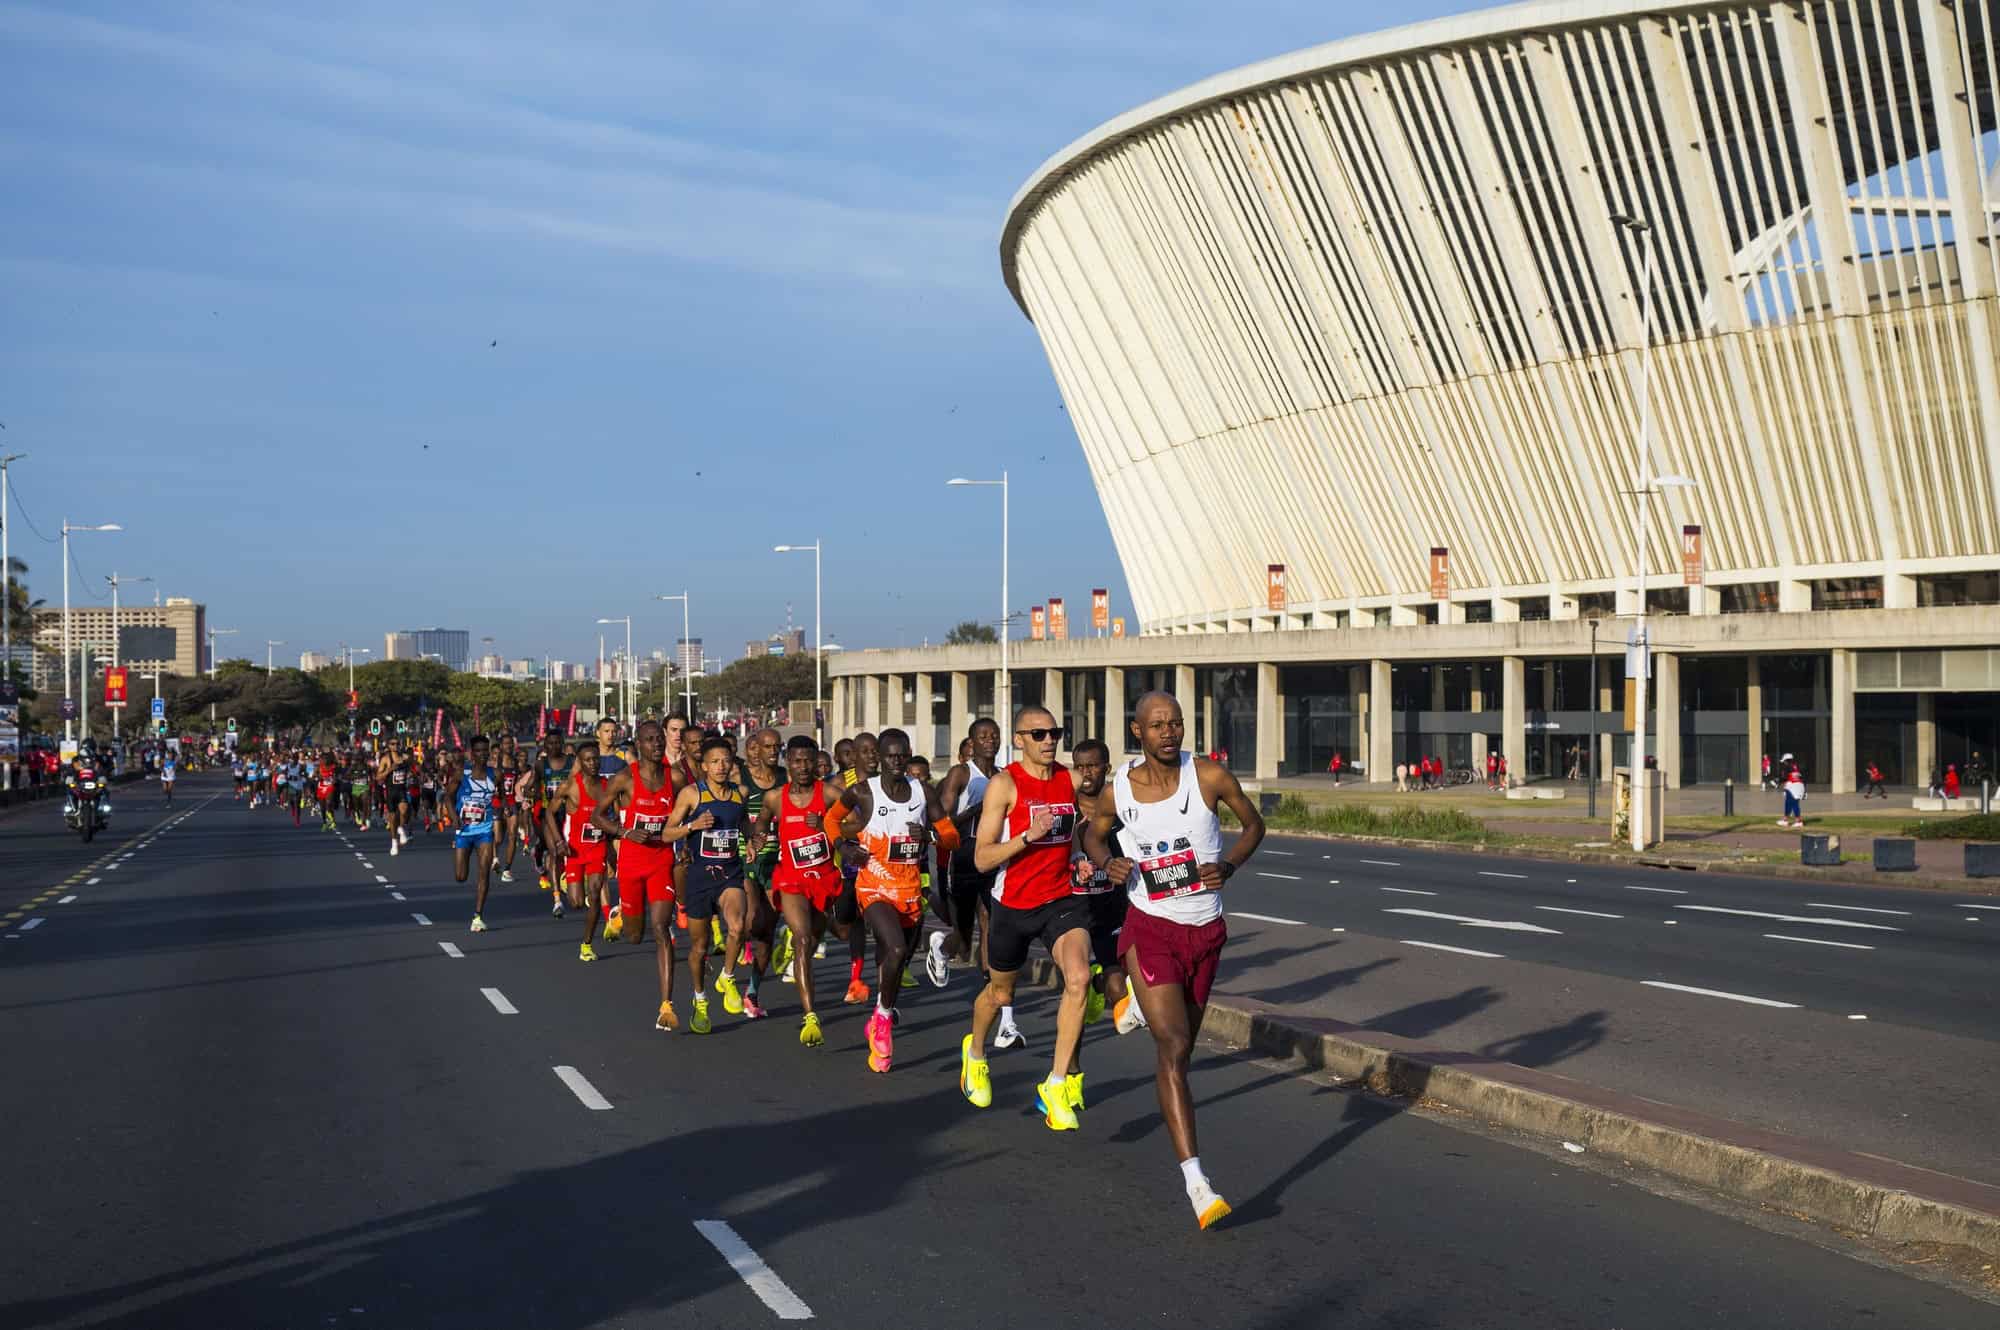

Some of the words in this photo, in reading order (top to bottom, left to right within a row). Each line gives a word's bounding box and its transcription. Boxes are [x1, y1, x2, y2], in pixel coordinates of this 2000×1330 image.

[1685, 535, 1697, 554] K
[1438, 556, 1448, 573] L
[1271, 572, 1284, 587] M
[1095, 595, 1106, 608] M
[798, 842, 822, 857] PRECIOUS
[1151, 863, 1189, 885] TUMISANG
[1173, 887, 1192, 897] 2024
